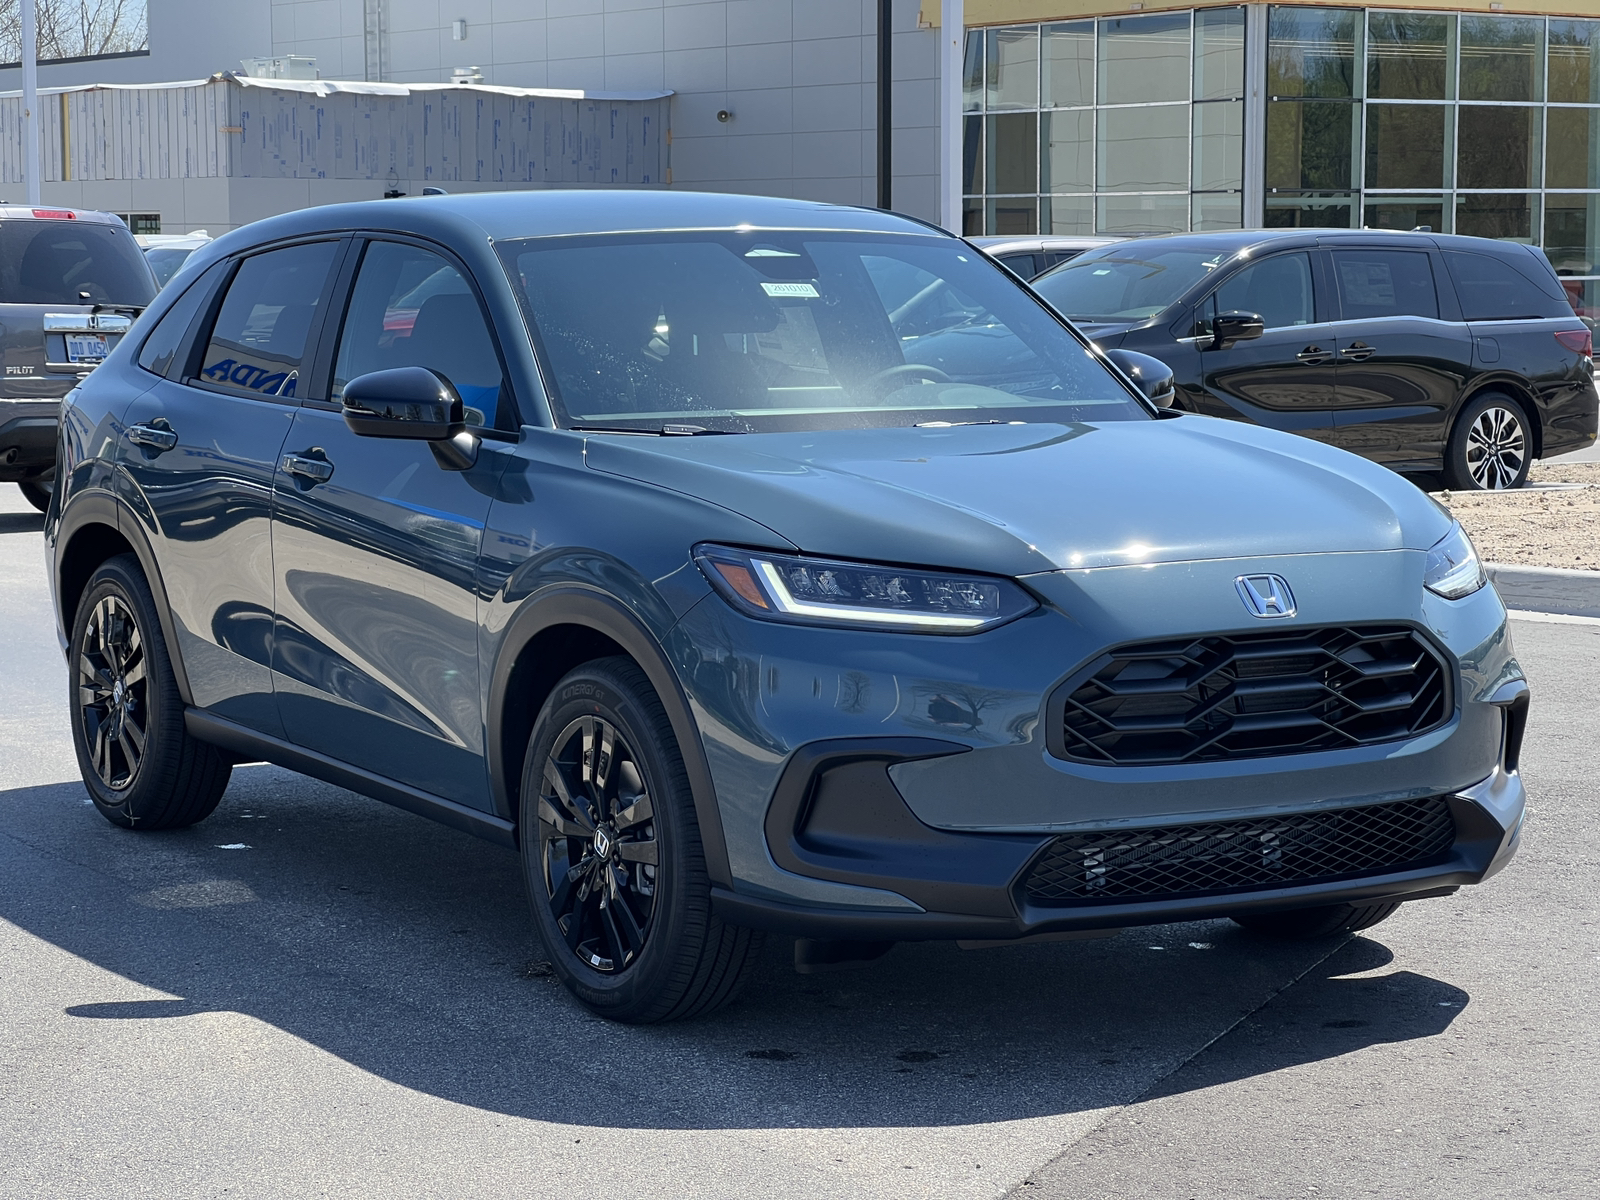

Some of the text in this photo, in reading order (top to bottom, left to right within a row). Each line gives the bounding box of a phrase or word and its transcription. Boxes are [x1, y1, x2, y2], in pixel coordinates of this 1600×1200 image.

[771, 284, 809, 292] 261010
[88, 342, 107, 355] 0452
[6, 366, 35, 375] PILOT
